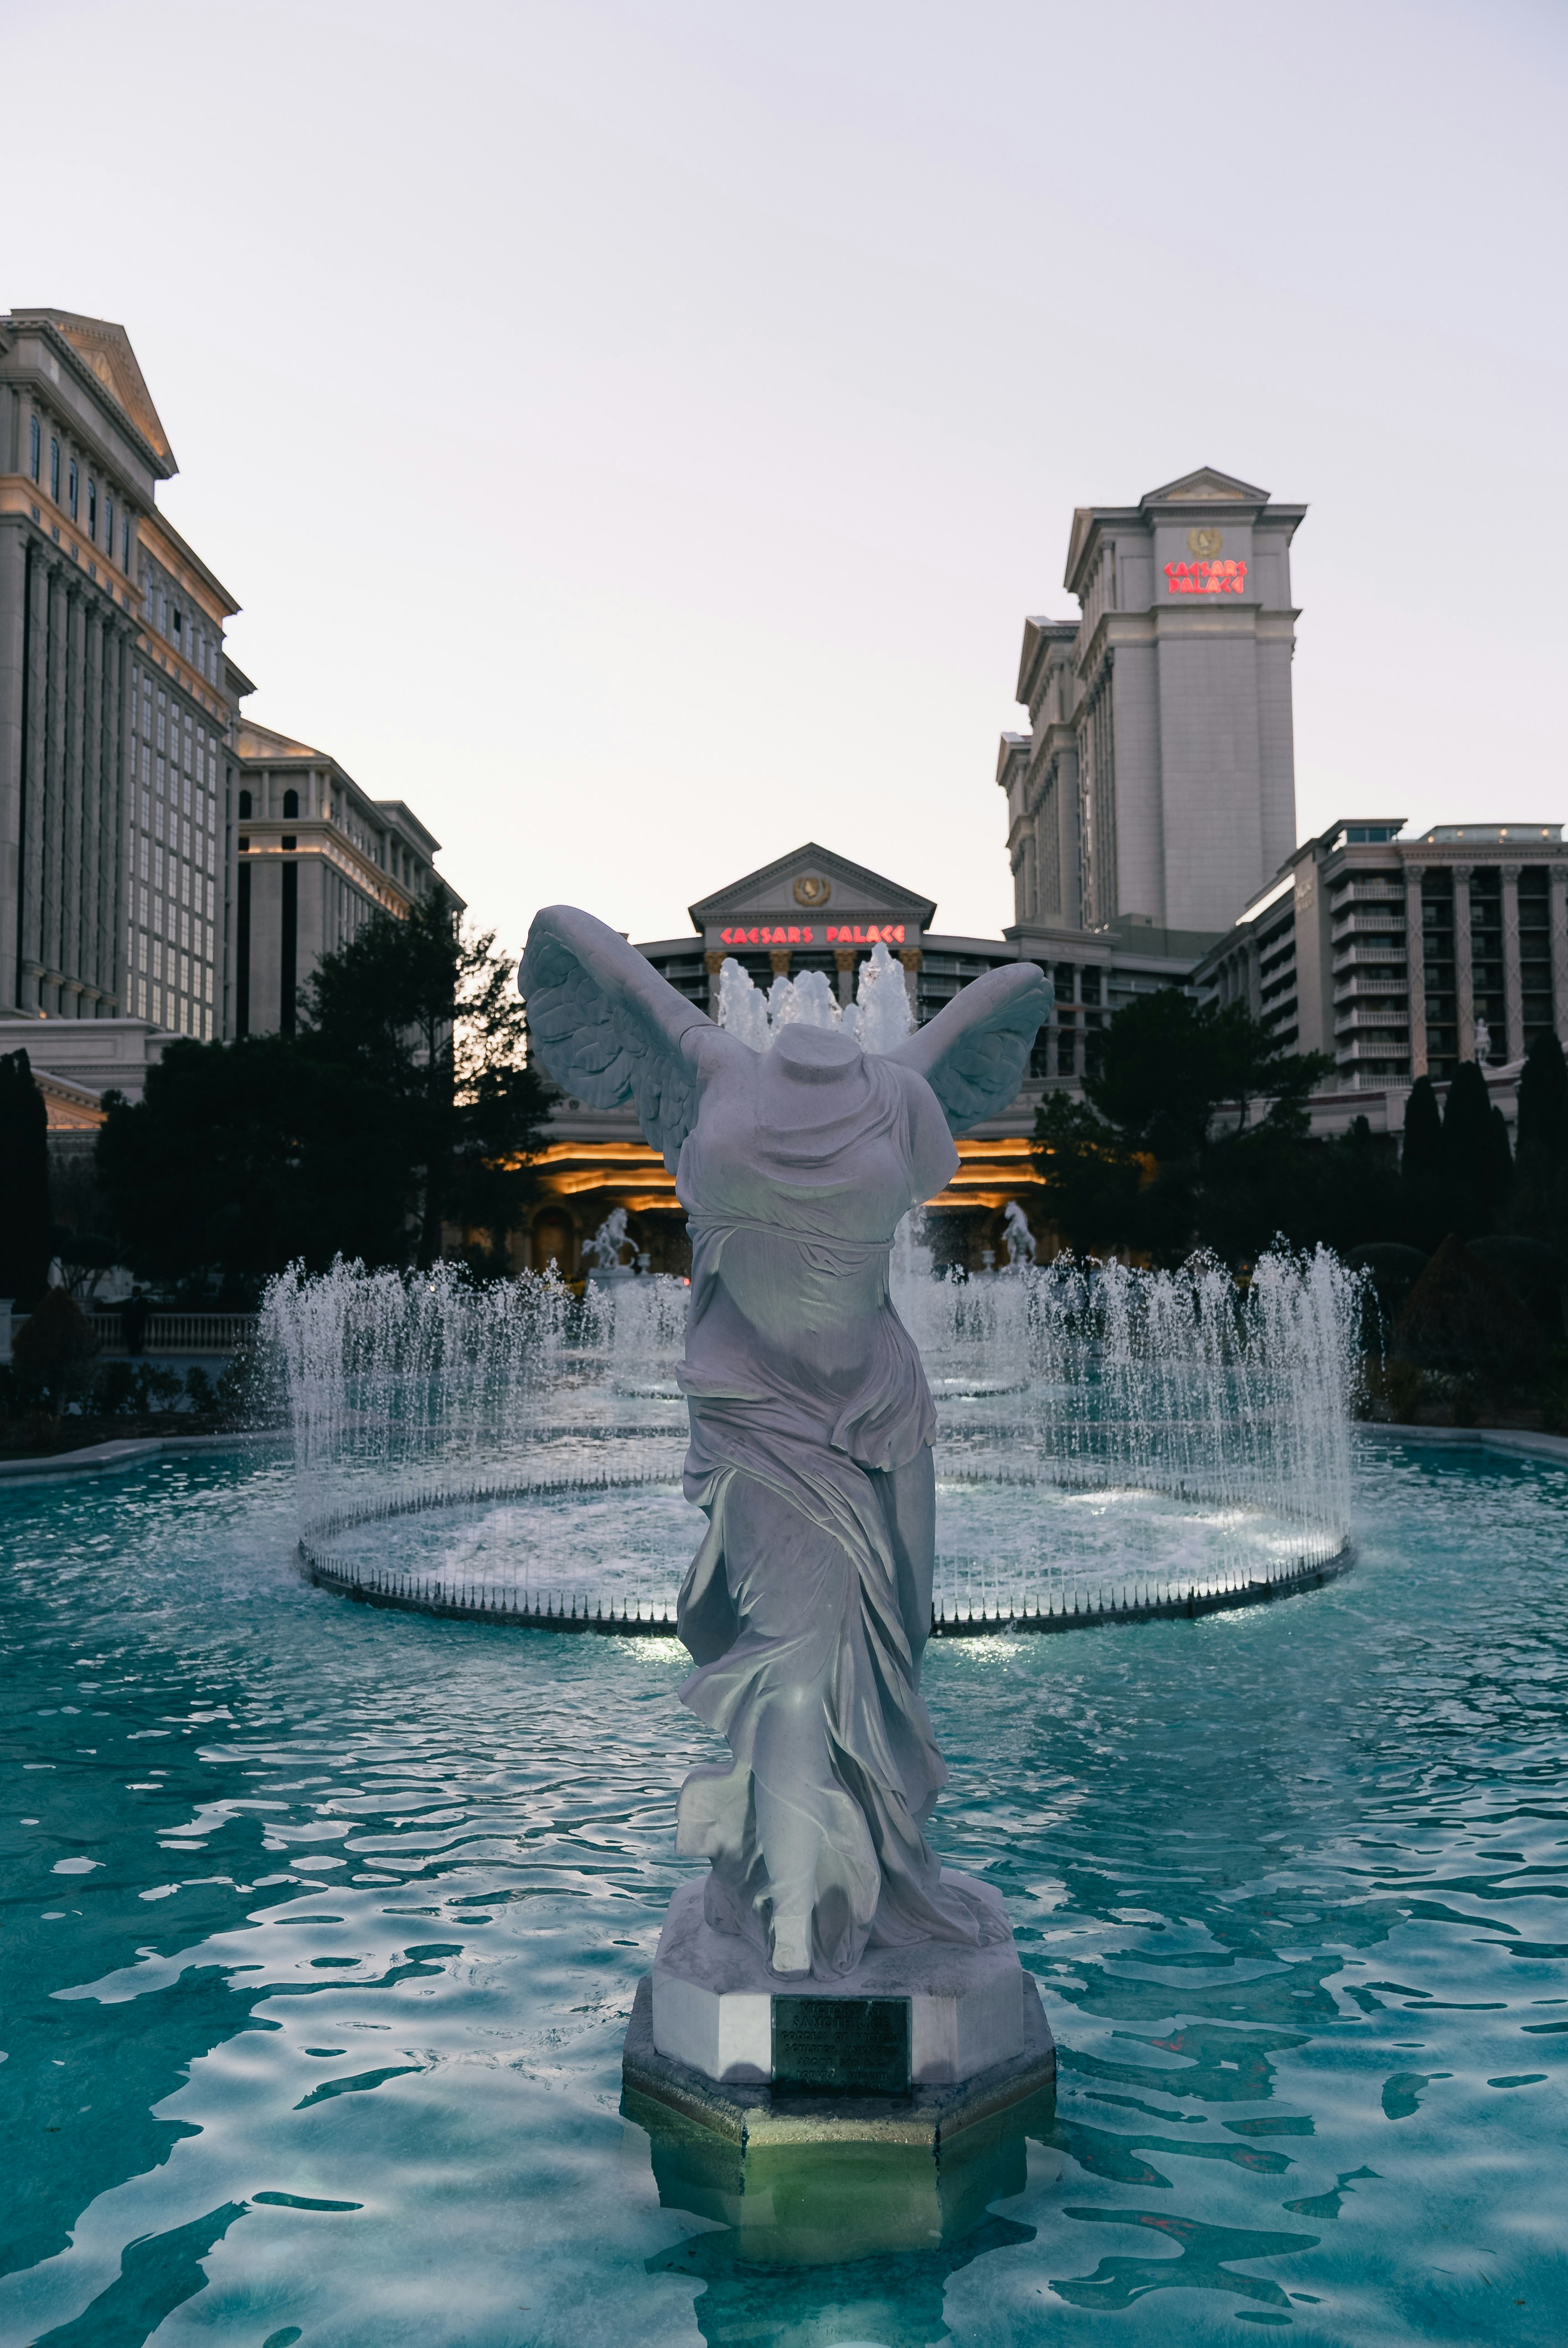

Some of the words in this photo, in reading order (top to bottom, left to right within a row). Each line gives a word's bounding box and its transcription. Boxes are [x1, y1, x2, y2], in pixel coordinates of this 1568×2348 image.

[1164, 560, 1248, 577] CAESARS
[1169, 576, 1244, 594] PALACE
[720, 926, 813, 944] CAESARS
[826, 925, 905, 943] PALACE
[801, 2002, 860, 2015] VICTORY
[866, 2004, 882, 2015] AT
[793, 2015, 889, 2028] SAMOTHRACE
[781, 2031, 828, 2040] GODDESS
[834, 2032, 848, 2041] OF
[855, 2032, 902, 2042] VICTORY
[785, 2043, 838, 2054] SCULPTOR
[798, 2057, 832, 2066] ABOUT
